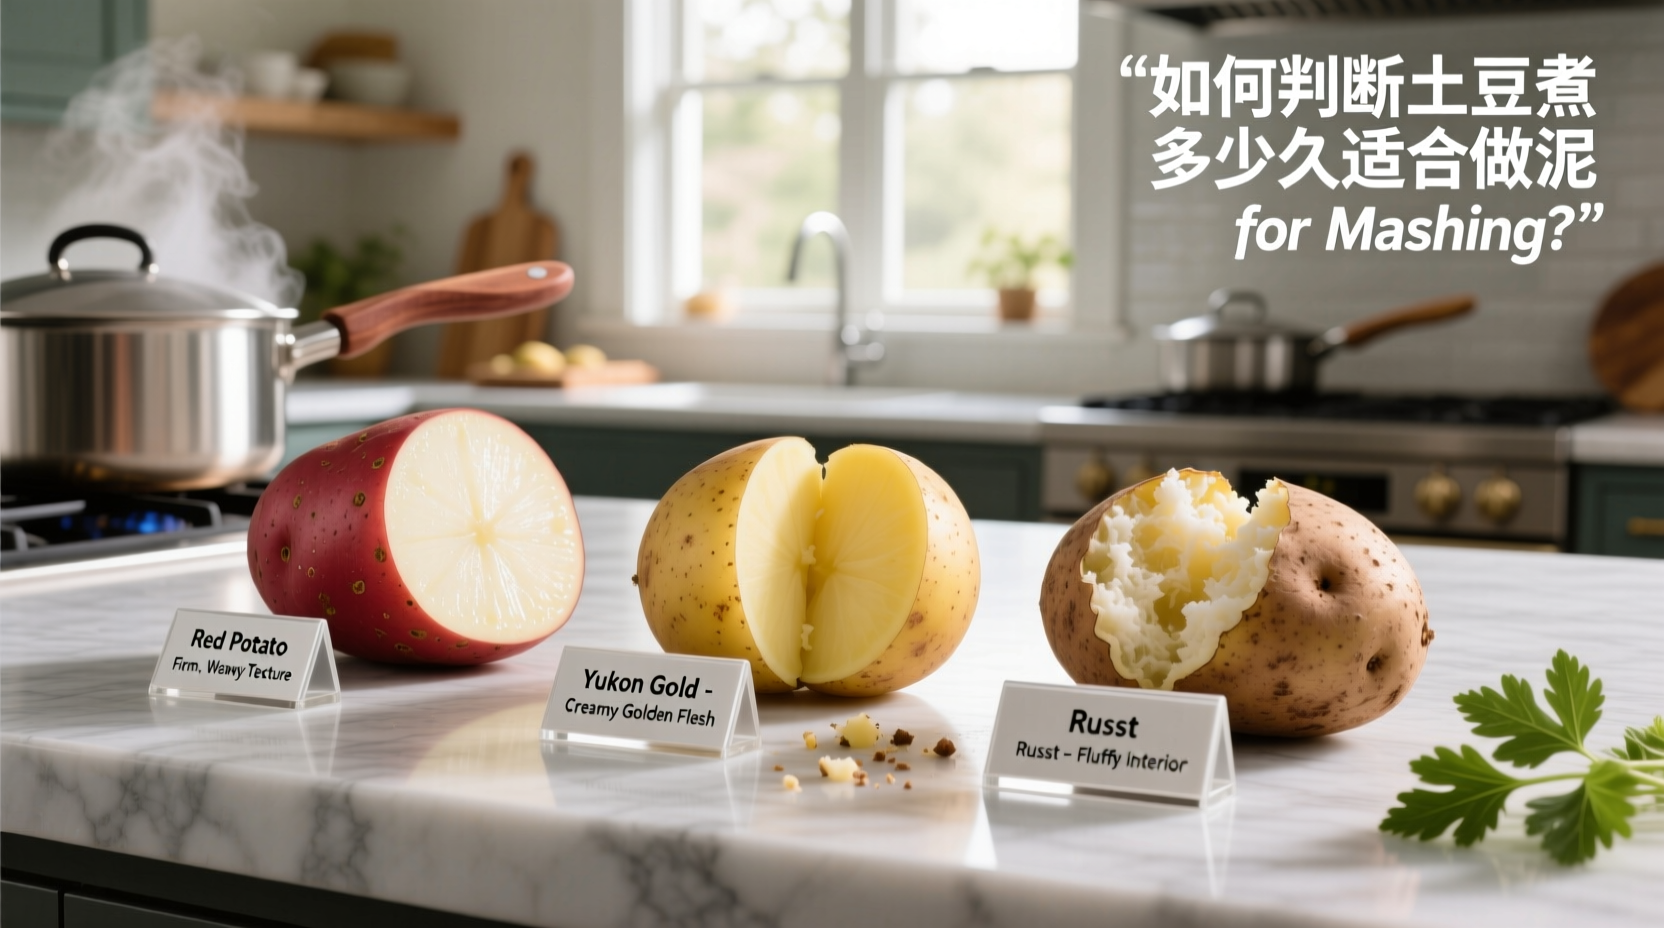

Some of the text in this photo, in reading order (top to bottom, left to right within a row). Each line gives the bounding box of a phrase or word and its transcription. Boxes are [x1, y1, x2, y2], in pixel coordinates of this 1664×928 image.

[190, 628, 289, 657] Red Potato
[584, 668, 644, 694] Yukon
[649, 674, 701, 700] Gold
[564, 697, 716, 728] Creamy Golden Flesh
[1068, 708, 1140, 738] Russt
[1015, 740, 1061, 761] Russt
[1076, 746, 1122, 770] Fluffy
[1126, 751, 1189, 773] Interior
